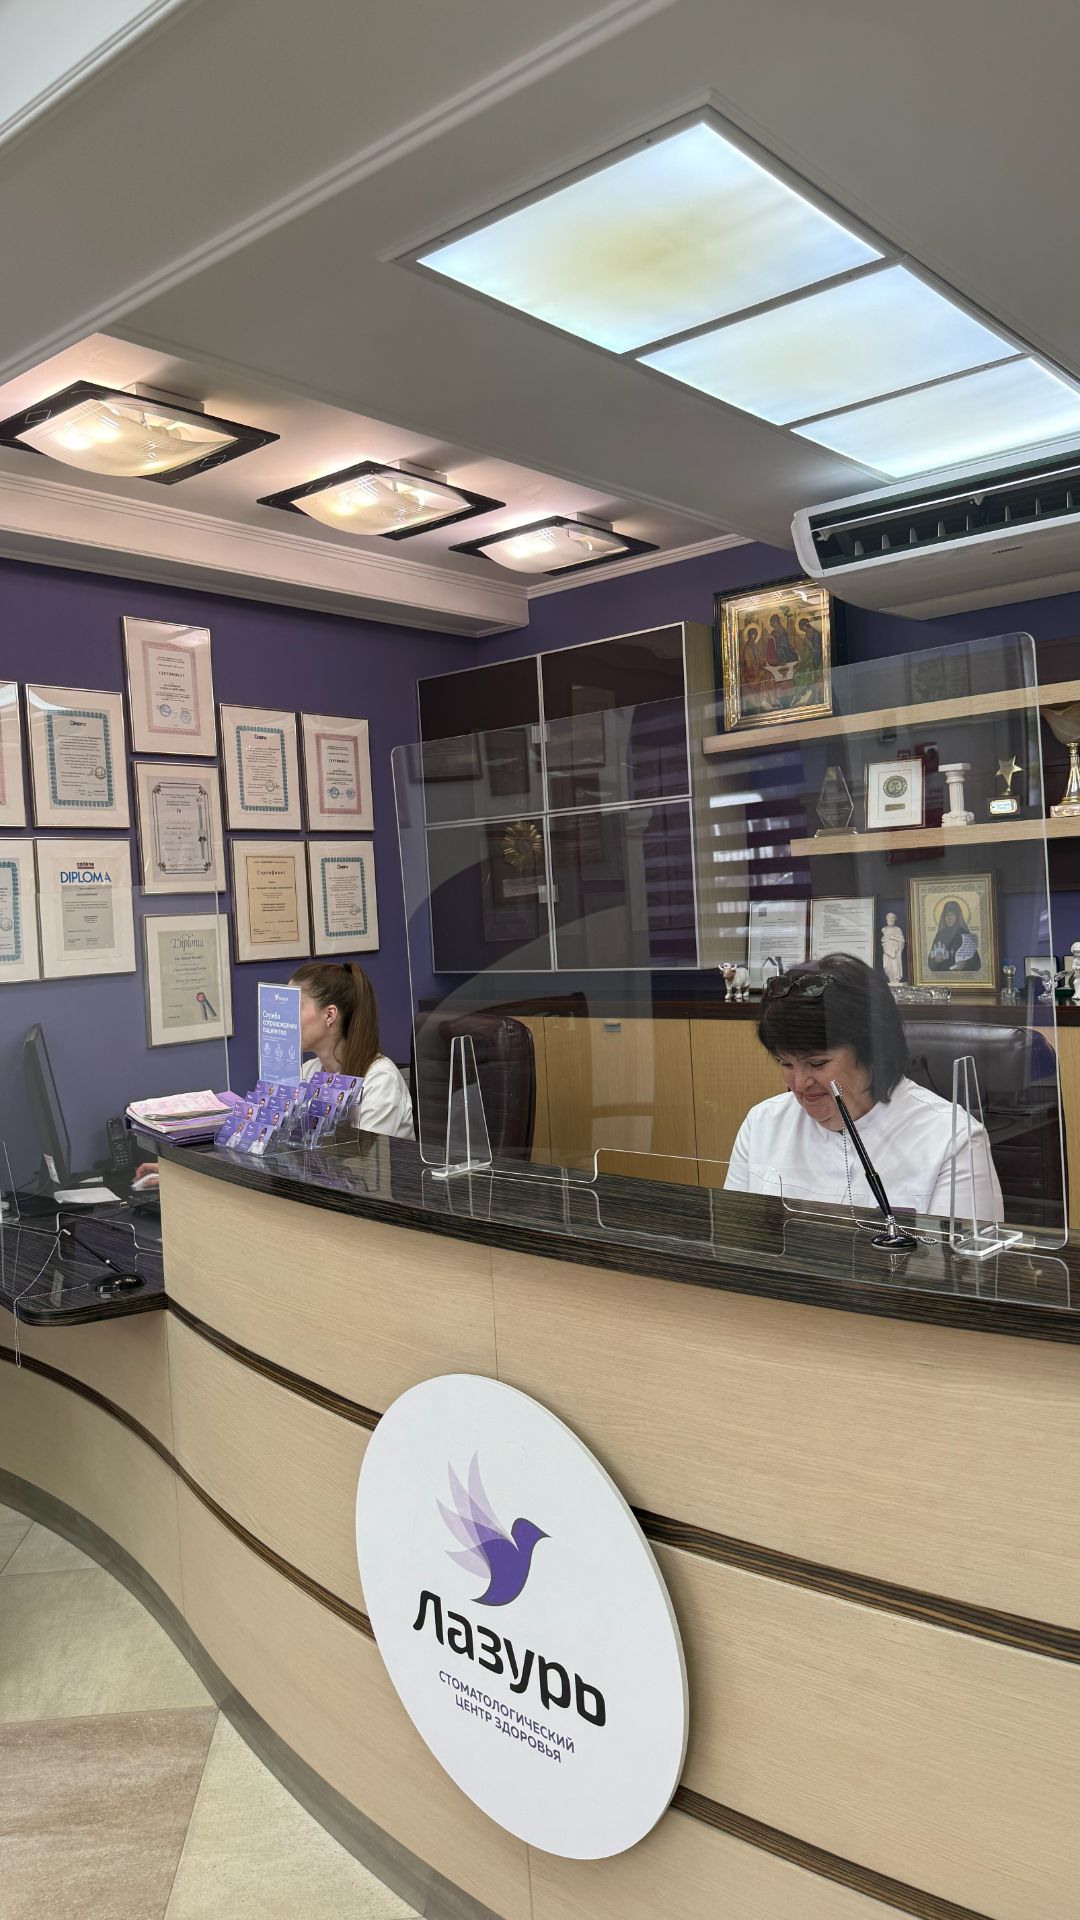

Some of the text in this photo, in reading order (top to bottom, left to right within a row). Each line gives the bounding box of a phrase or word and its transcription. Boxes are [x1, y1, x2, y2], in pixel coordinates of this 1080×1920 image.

[60, 871, 112, 883] DIPLOMA
[169, 933, 204, 950] Diploma
[262, 1010, 281, 1020] Служба
[262, 1019, 298, 1030] сопровождения
[412, 1590, 607, 1727] Лазурь
[438, 1670, 576, 1754] СТОМАТОЛОГИЧЕСКИЙ
[455, 1693, 562, 1764] ЦЕНТР ЗДОРОВЬЯ
